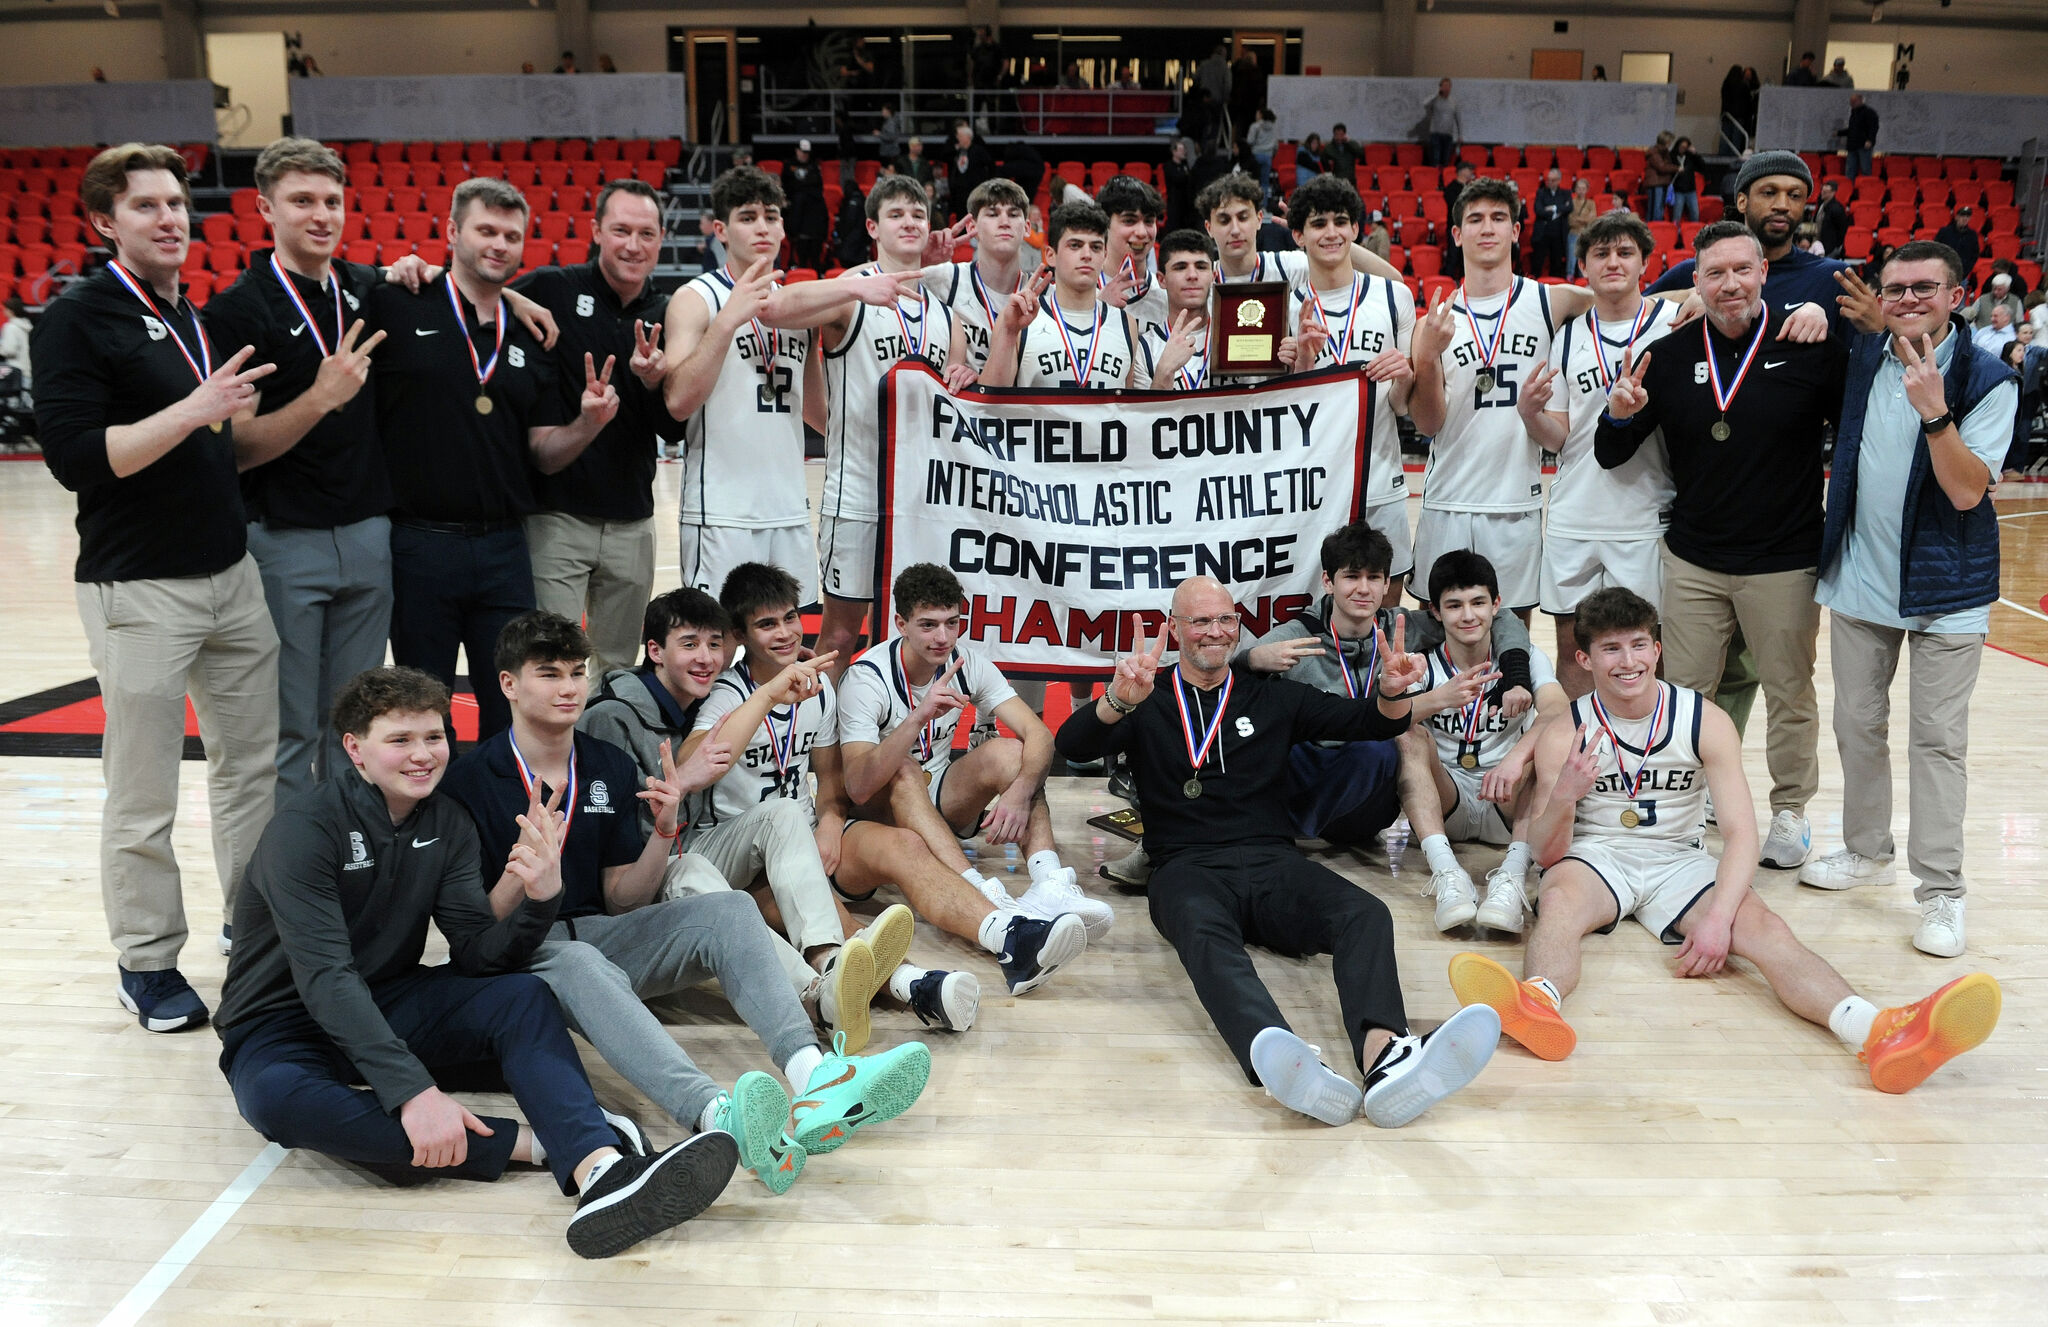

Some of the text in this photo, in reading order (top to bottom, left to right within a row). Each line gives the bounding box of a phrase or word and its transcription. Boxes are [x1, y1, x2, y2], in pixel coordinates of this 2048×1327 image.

[1897, 43, 1915, 62] M
[576, 294, 594, 317] S
[508, 345, 525, 368] S
[1453, 333, 1538, 367] STLES
[1474, 363, 1517, 410] 25
[1694, 361, 1709, 384] S
[757, 365, 793, 413] 22
[932, 393, 1320, 463] FAIRFIELD COUNTY
[926, 459, 1327, 527] INTERSCHOLASTIC ATHLETIC
[949, 528, 1298, 590] CONFERENCE
[833, 568, 840, 589] S
[957, 593, 1314, 652] HAMPNS
[1235, 716, 1255, 737] S
[590, 780, 609, 805] S
[349, 831, 367, 861] S
